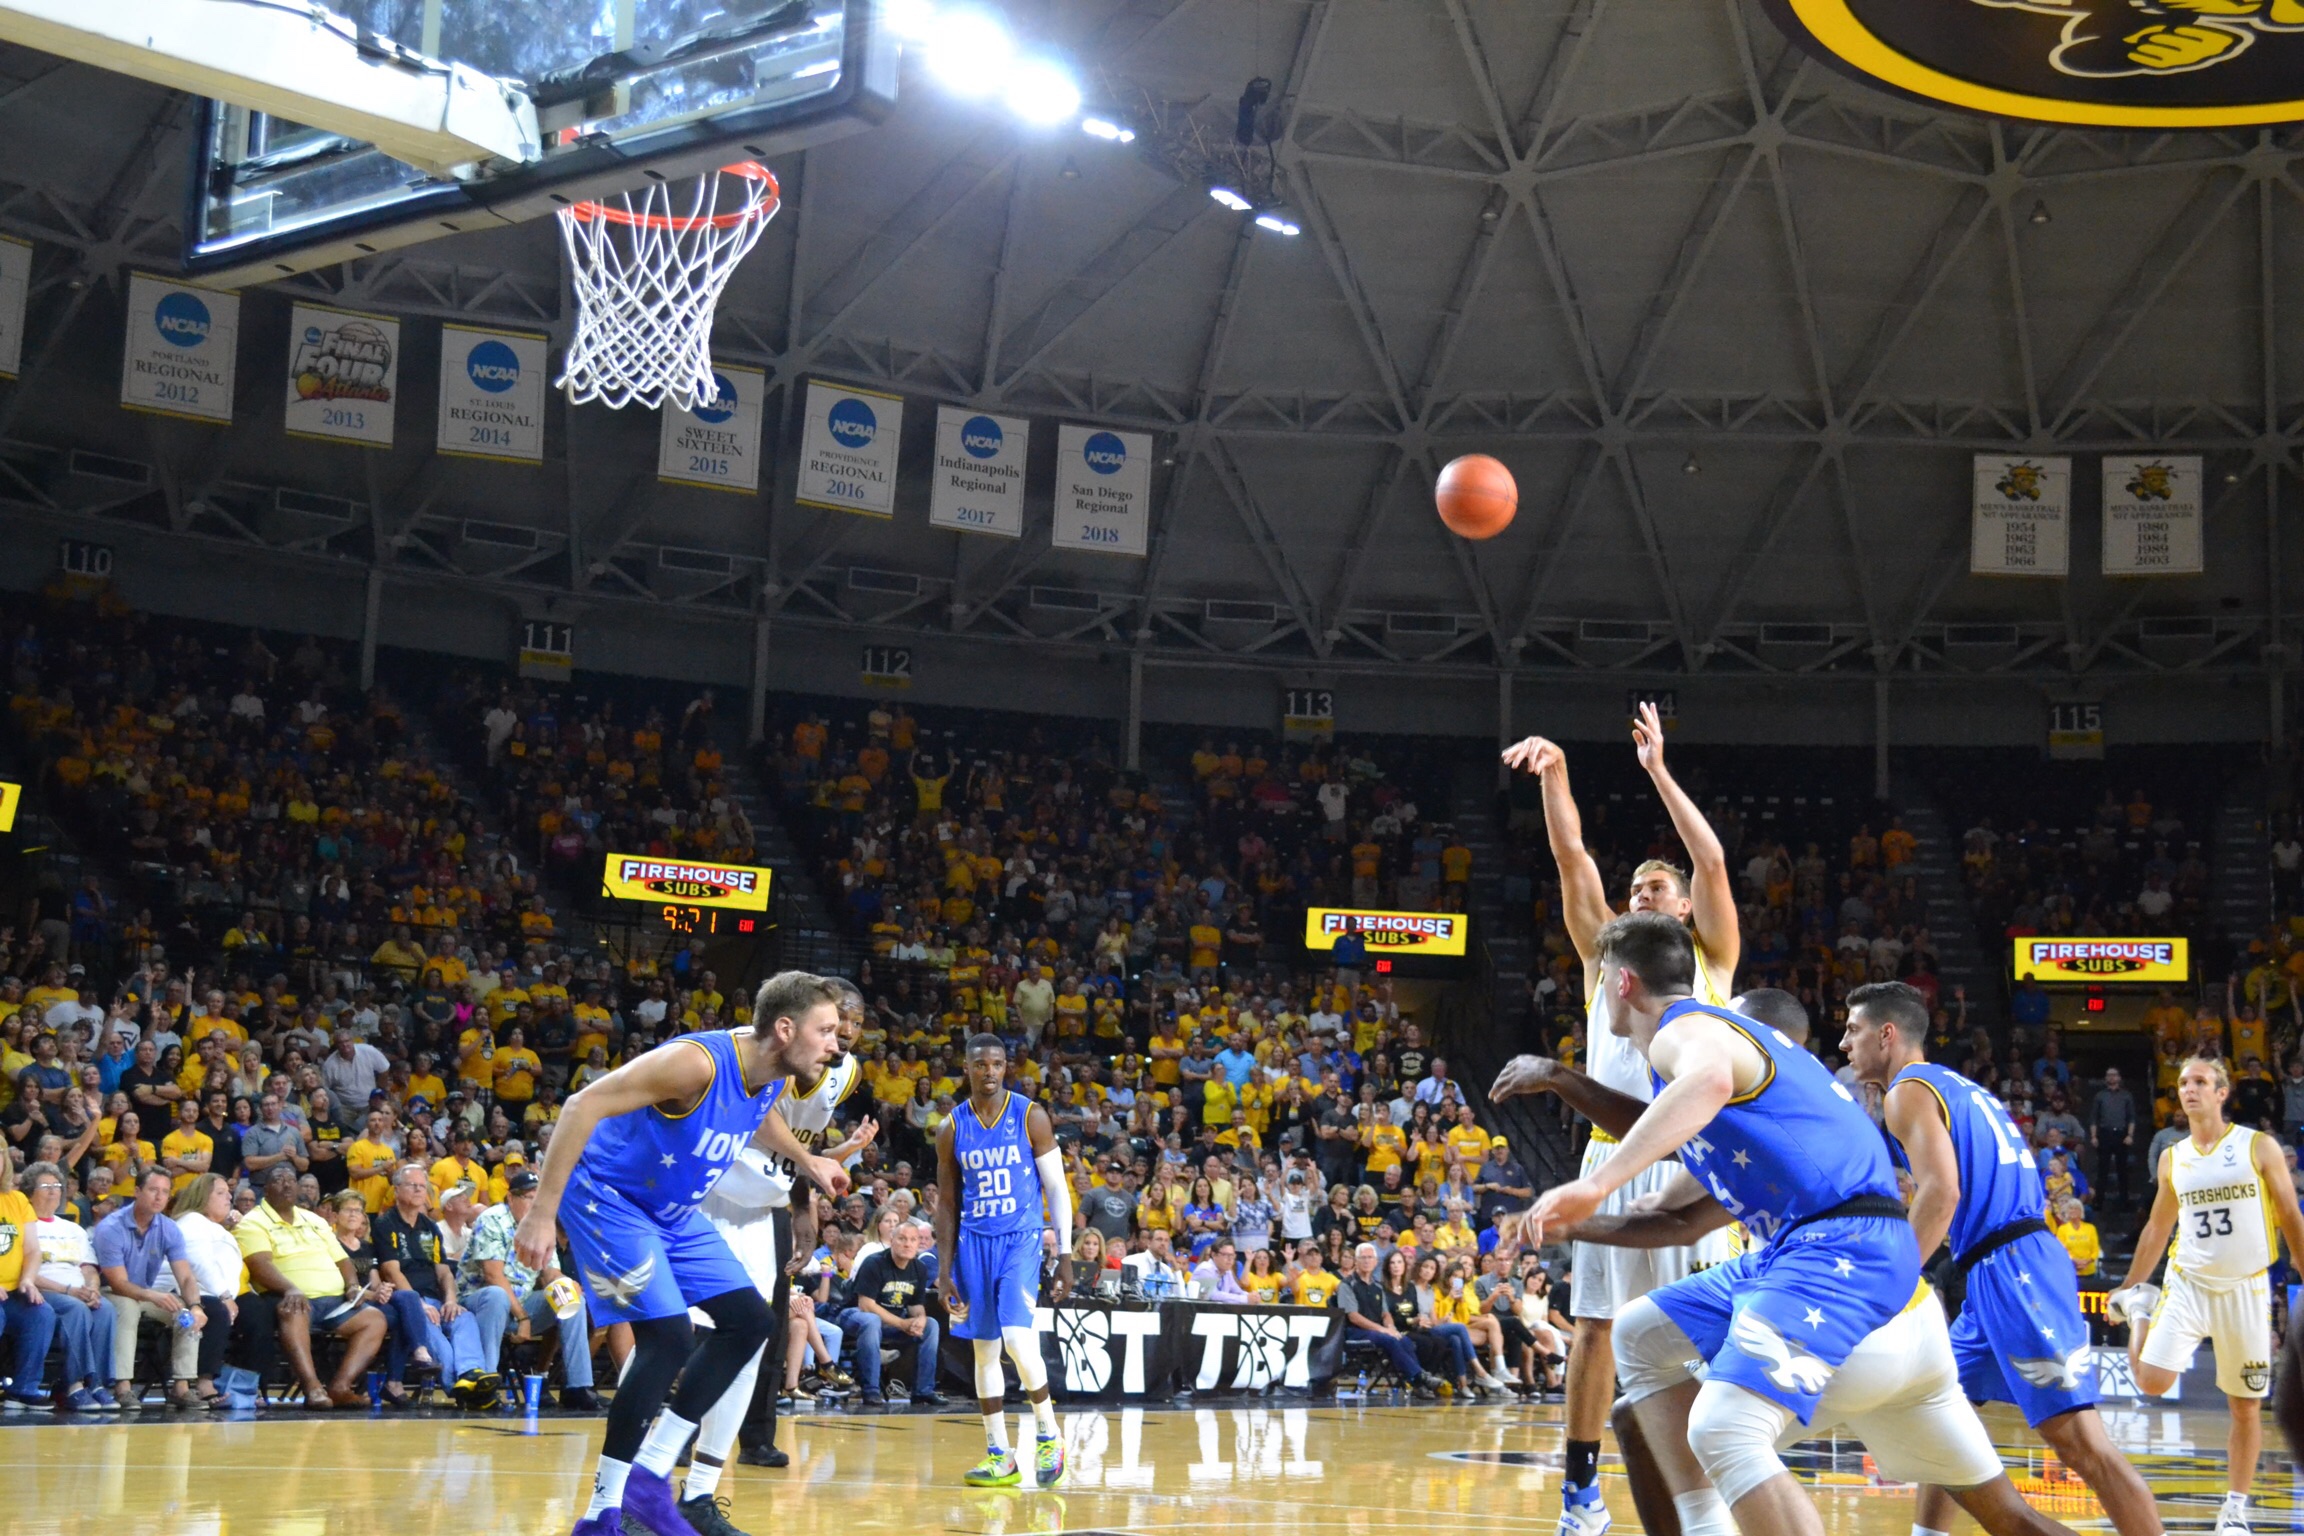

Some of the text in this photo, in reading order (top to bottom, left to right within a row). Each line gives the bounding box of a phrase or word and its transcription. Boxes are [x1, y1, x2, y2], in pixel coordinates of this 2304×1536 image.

[161, 316, 208, 335] NCAA
[321, 330, 385, 364] FINAL
[153, 351, 209, 366] PORTLAND
[292, 344, 385, 388] FOUR
[136, 359, 224, 386] REGIONAL
[472, 363, 518, 381] NCAA
[155, 381, 199, 404] 2012
[485, 399, 516, 410] LOUIS
[322, 408, 364, 429] 2013
[450, 407, 534, 427] REGIONAL
[470, 426, 511, 446] 2014
[685, 427, 737, 444] SWEET
[832, 419, 875, 438] NCAA
[676, 437, 743, 457] SIXTEEN
[965, 434, 1001, 449] NCAA
[689, 456, 728, 475] 2015
[819, 450, 879, 467] PROVIDENCE
[939, 455, 1020, 478] Indianapolis
[1087, 451, 1125, 465] NCAA
[810, 459, 887, 483] REGIONAL
[826, 479, 864, 500] 2016
[951, 475, 1007, 494] Regional
[1072, 484, 1133, 502] San Diego
[957, 506, 995, 524] 2017
[1075, 499, 1128, 514] Regional
[1081, 525, 1119, 542] 2018
[2005, 522, 2036, 532] 1954
[2137, 522, 2169, 532] 1980
[2005, 533, 2036, 543] 1962
[2137, 533, 2168, 543] 1984
[2136, 544, 2169, 555] 1989
[62, 542, 112, 578] 110
[2004, 556, 2036, 566] 1966
[2135, 555, 2170, 566] 2003
[525, 623, 572, 654] 111
[864, 648, 910, 675] 112
[1287, 691, 1332, 716] 113
[2052, 706, 2101, 731] 115
[622, 861, 755, 894] FIREHOUSE
[664, 881, 711, 897] SUBS
[1363, 930, 1410, 945] SUBS
[2033, 943, 2170, 966] FIREHOUSE
[2076, 959, 2127, 972] SUBS
[691, 1127, 757, 1163] IOW
[960, 1145, 1022, 1170] IOWA
[977, 1168, 1012, 1198] 20
[2179, 1183, 2256, 1207] FTERSHOCKS
[972, 1197, 1017, 1218] UTD
[2193, 1208, 2233, 1238] 33
[1191, 1312, 1331, 1391] TBT
